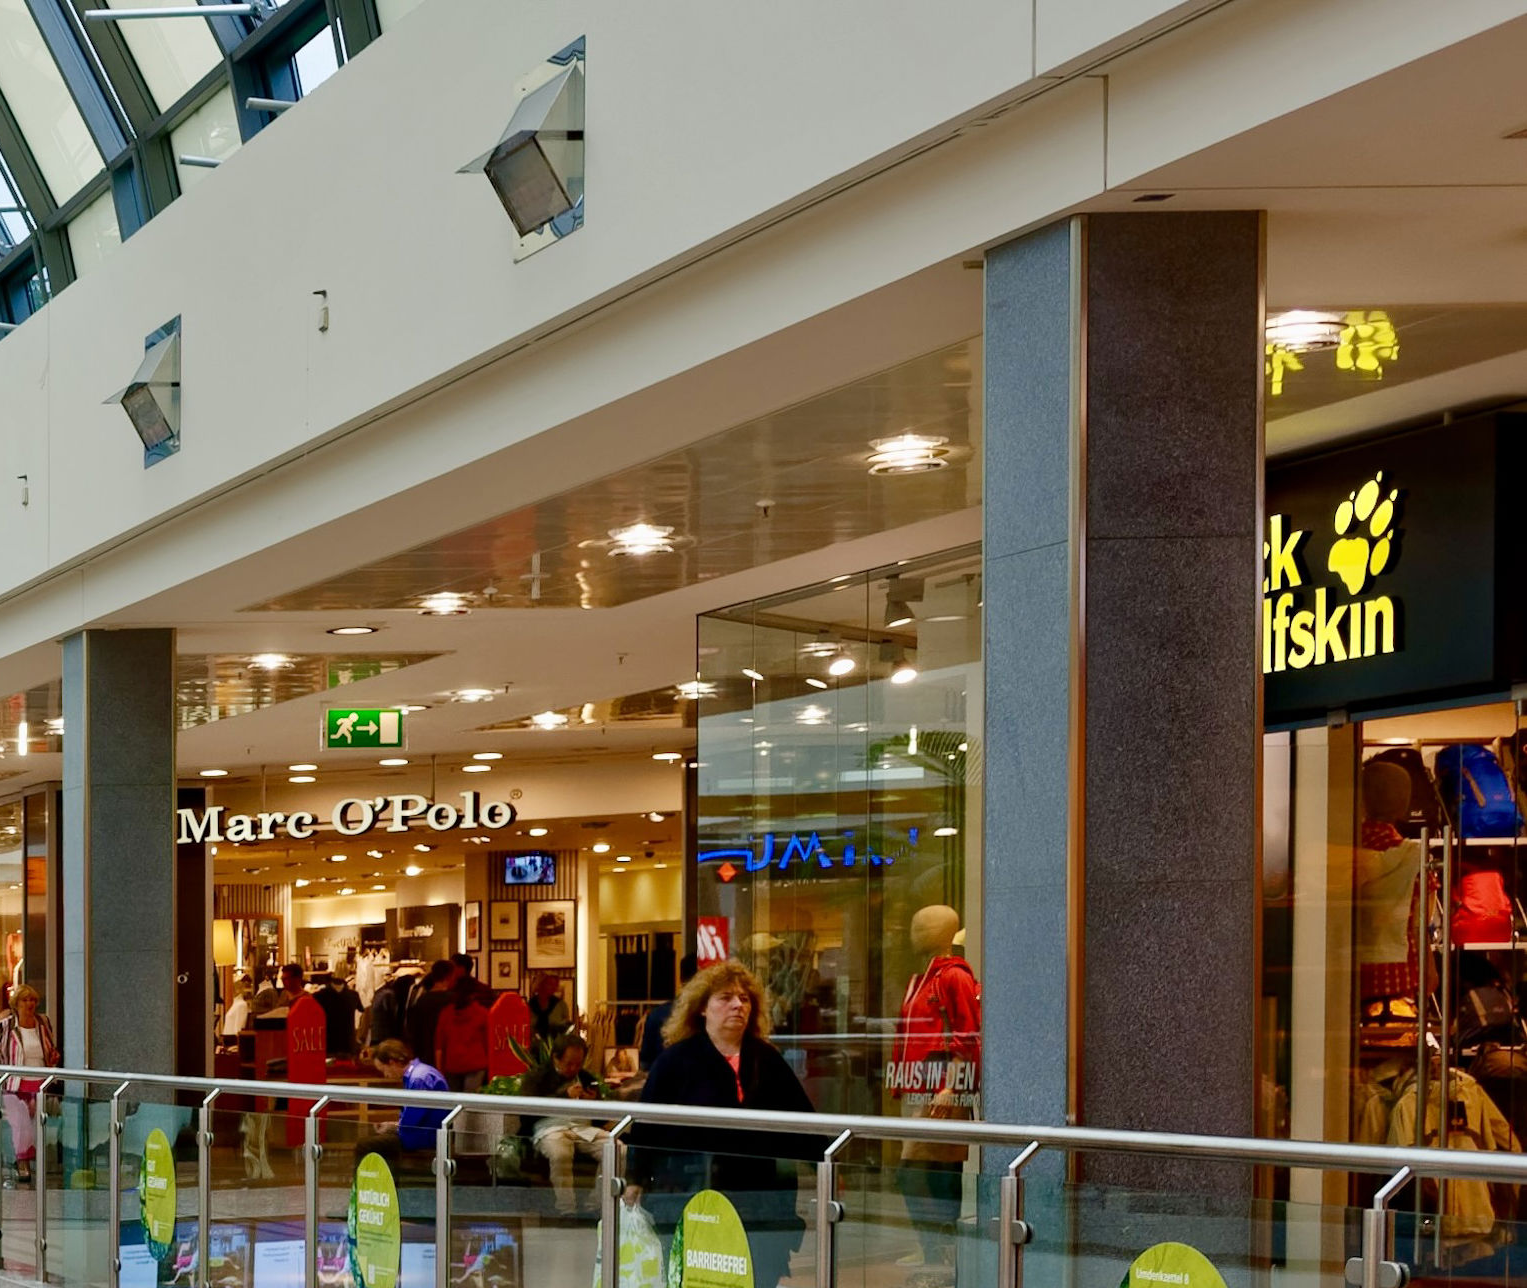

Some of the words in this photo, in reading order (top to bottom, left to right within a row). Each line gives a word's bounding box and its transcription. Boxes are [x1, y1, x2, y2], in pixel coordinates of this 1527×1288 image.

[177, 806, 314, 844] Marc
[331, 791, 515, 836] O'Polo
[292, 1025, 325, 1053] SALE
[886, 1061, 924, 1090] RAUS
[926, 1061, 943, 1089] IN
[945, 1061, 976, 1090] DEN
[686, 1249, 747, 1275] BARRIEREFREI
